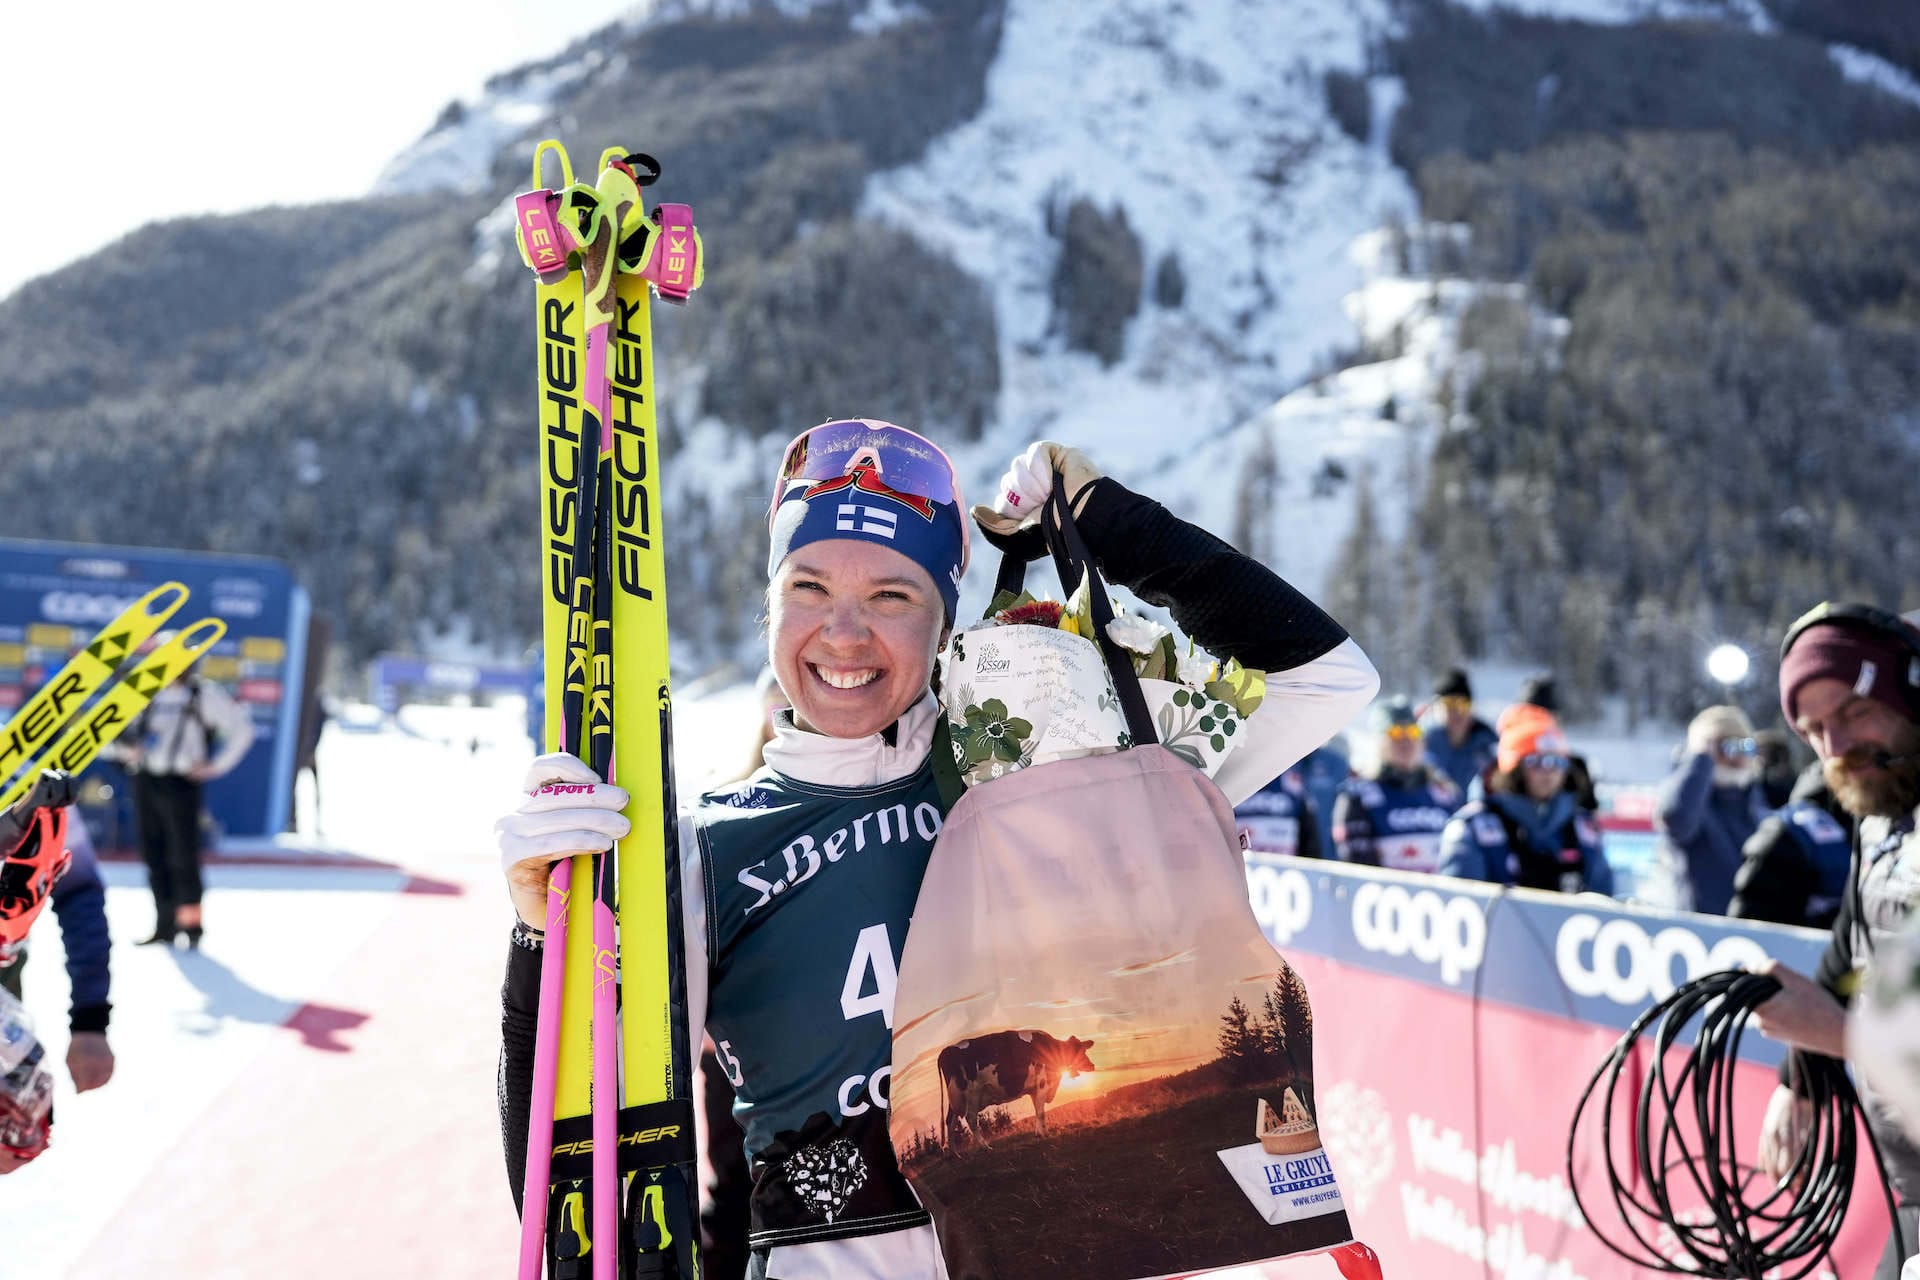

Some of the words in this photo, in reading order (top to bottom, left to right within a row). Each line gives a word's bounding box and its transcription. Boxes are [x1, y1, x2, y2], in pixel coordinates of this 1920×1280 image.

[524, 208, 558, 265] LEKI
[666, 225, 687, 285] LEKI
[544, 297, 580, 607] FISCHER
[612, 297, 653, 602] FISCHER
[566, 575, 594, 693] LEKI
[591, 619, 612, 737] LEKI
[0, 671, 88, 762] HER
[1246, 865, 1313, 945] op
[1351, 881, 1486, 986] coop
[839, 922, 899, 1030] 4
[551, 1124, 682, 1159] FISHER
[1263, 1163, 1286, 1184] LE
